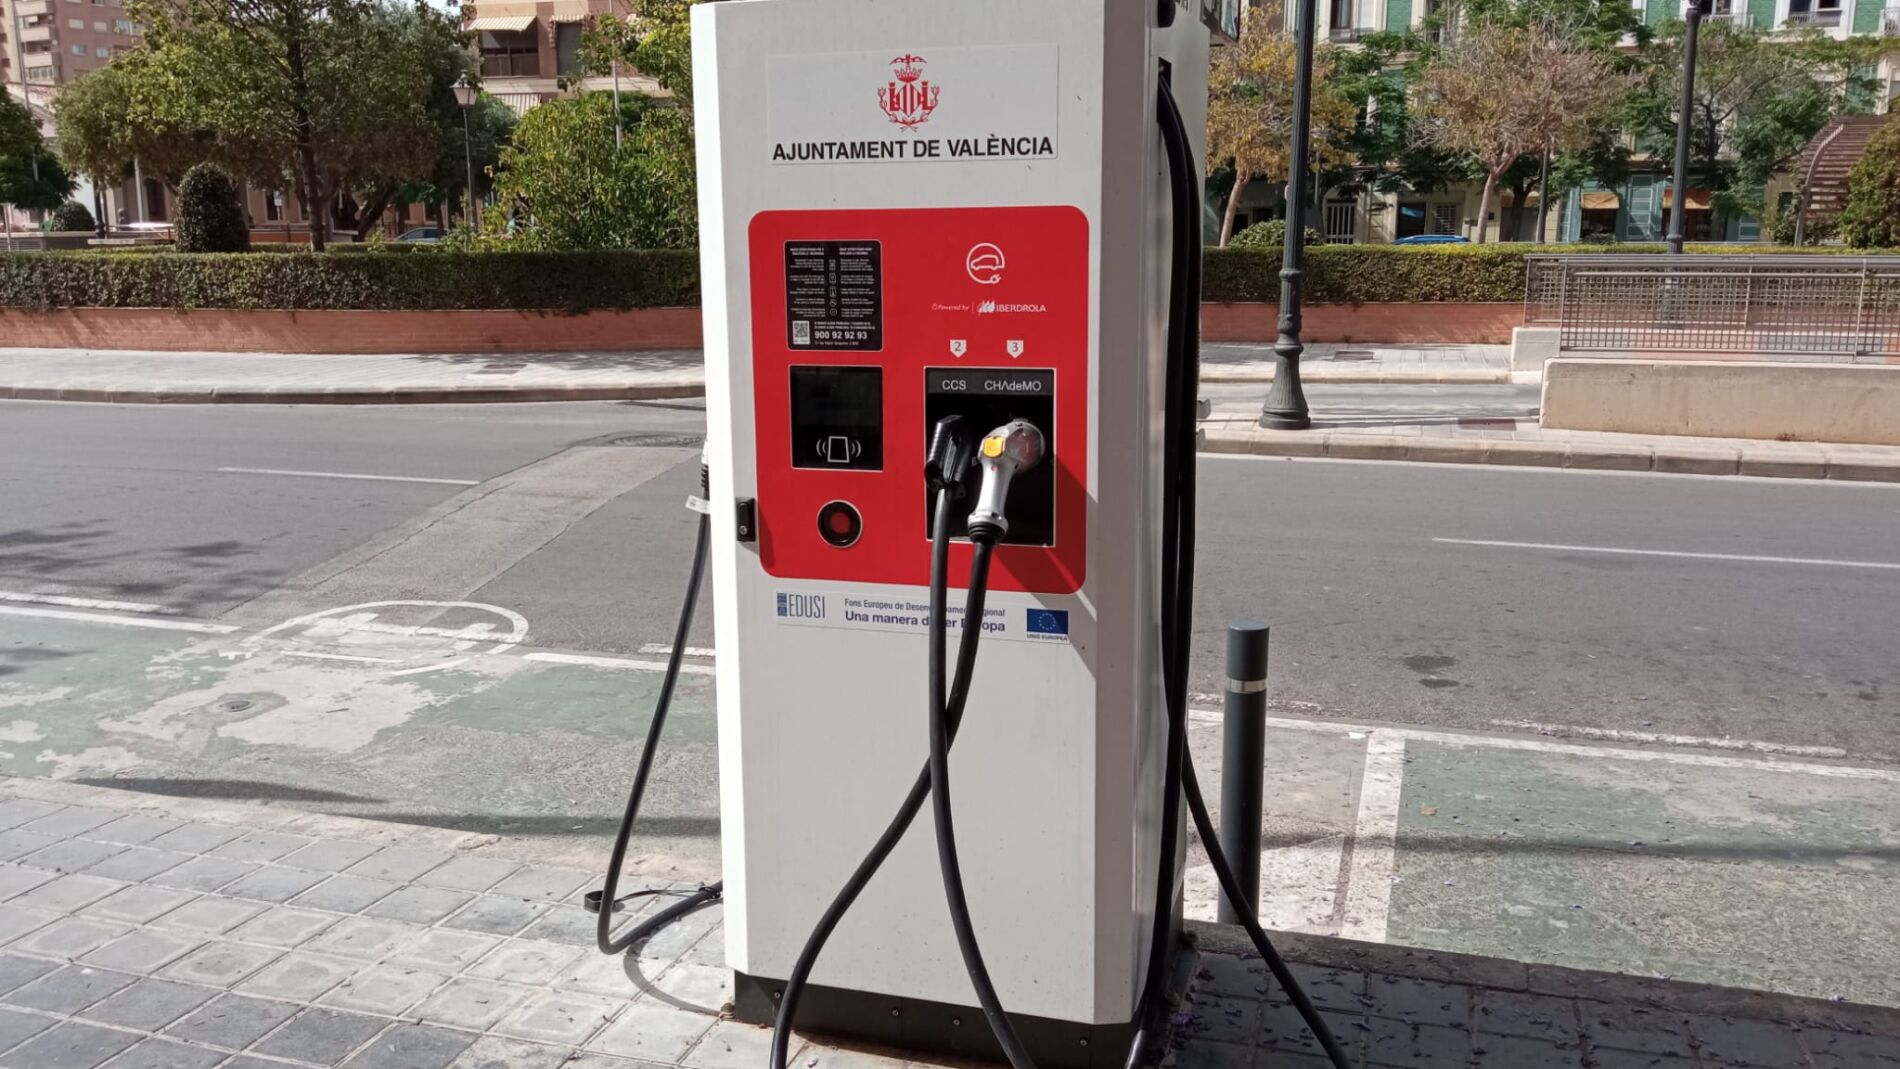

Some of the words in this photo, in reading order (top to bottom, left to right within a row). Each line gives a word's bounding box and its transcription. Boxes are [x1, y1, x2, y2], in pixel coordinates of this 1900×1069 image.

[772, 140, 908, 161] AJUNTAMENT
[913, 139, 940, 158] DE
[947, 133, 1053, 157] VALÈNCIA
[996, 304, 1047, 313] IBERDROLA
[814, 330, 830, 339] 900
[832, 330, 842, 340] 92
[844, 330, 855, 340] 92
[857, 330, 868, 340] 93
[953, 341, 962, 352] 2
[1011, 342, 1019, 353] 3
[942, 379, 967, 391] CCS
[788, 593, 826, 619] EDUSI
[844, 598, 863, 608] Fons
[863, 599, 893, 611] Europeu
[894, 602, 905, 610] de
[844, 610, 870, 622] Una
[872, 613, 919, 626] manera
